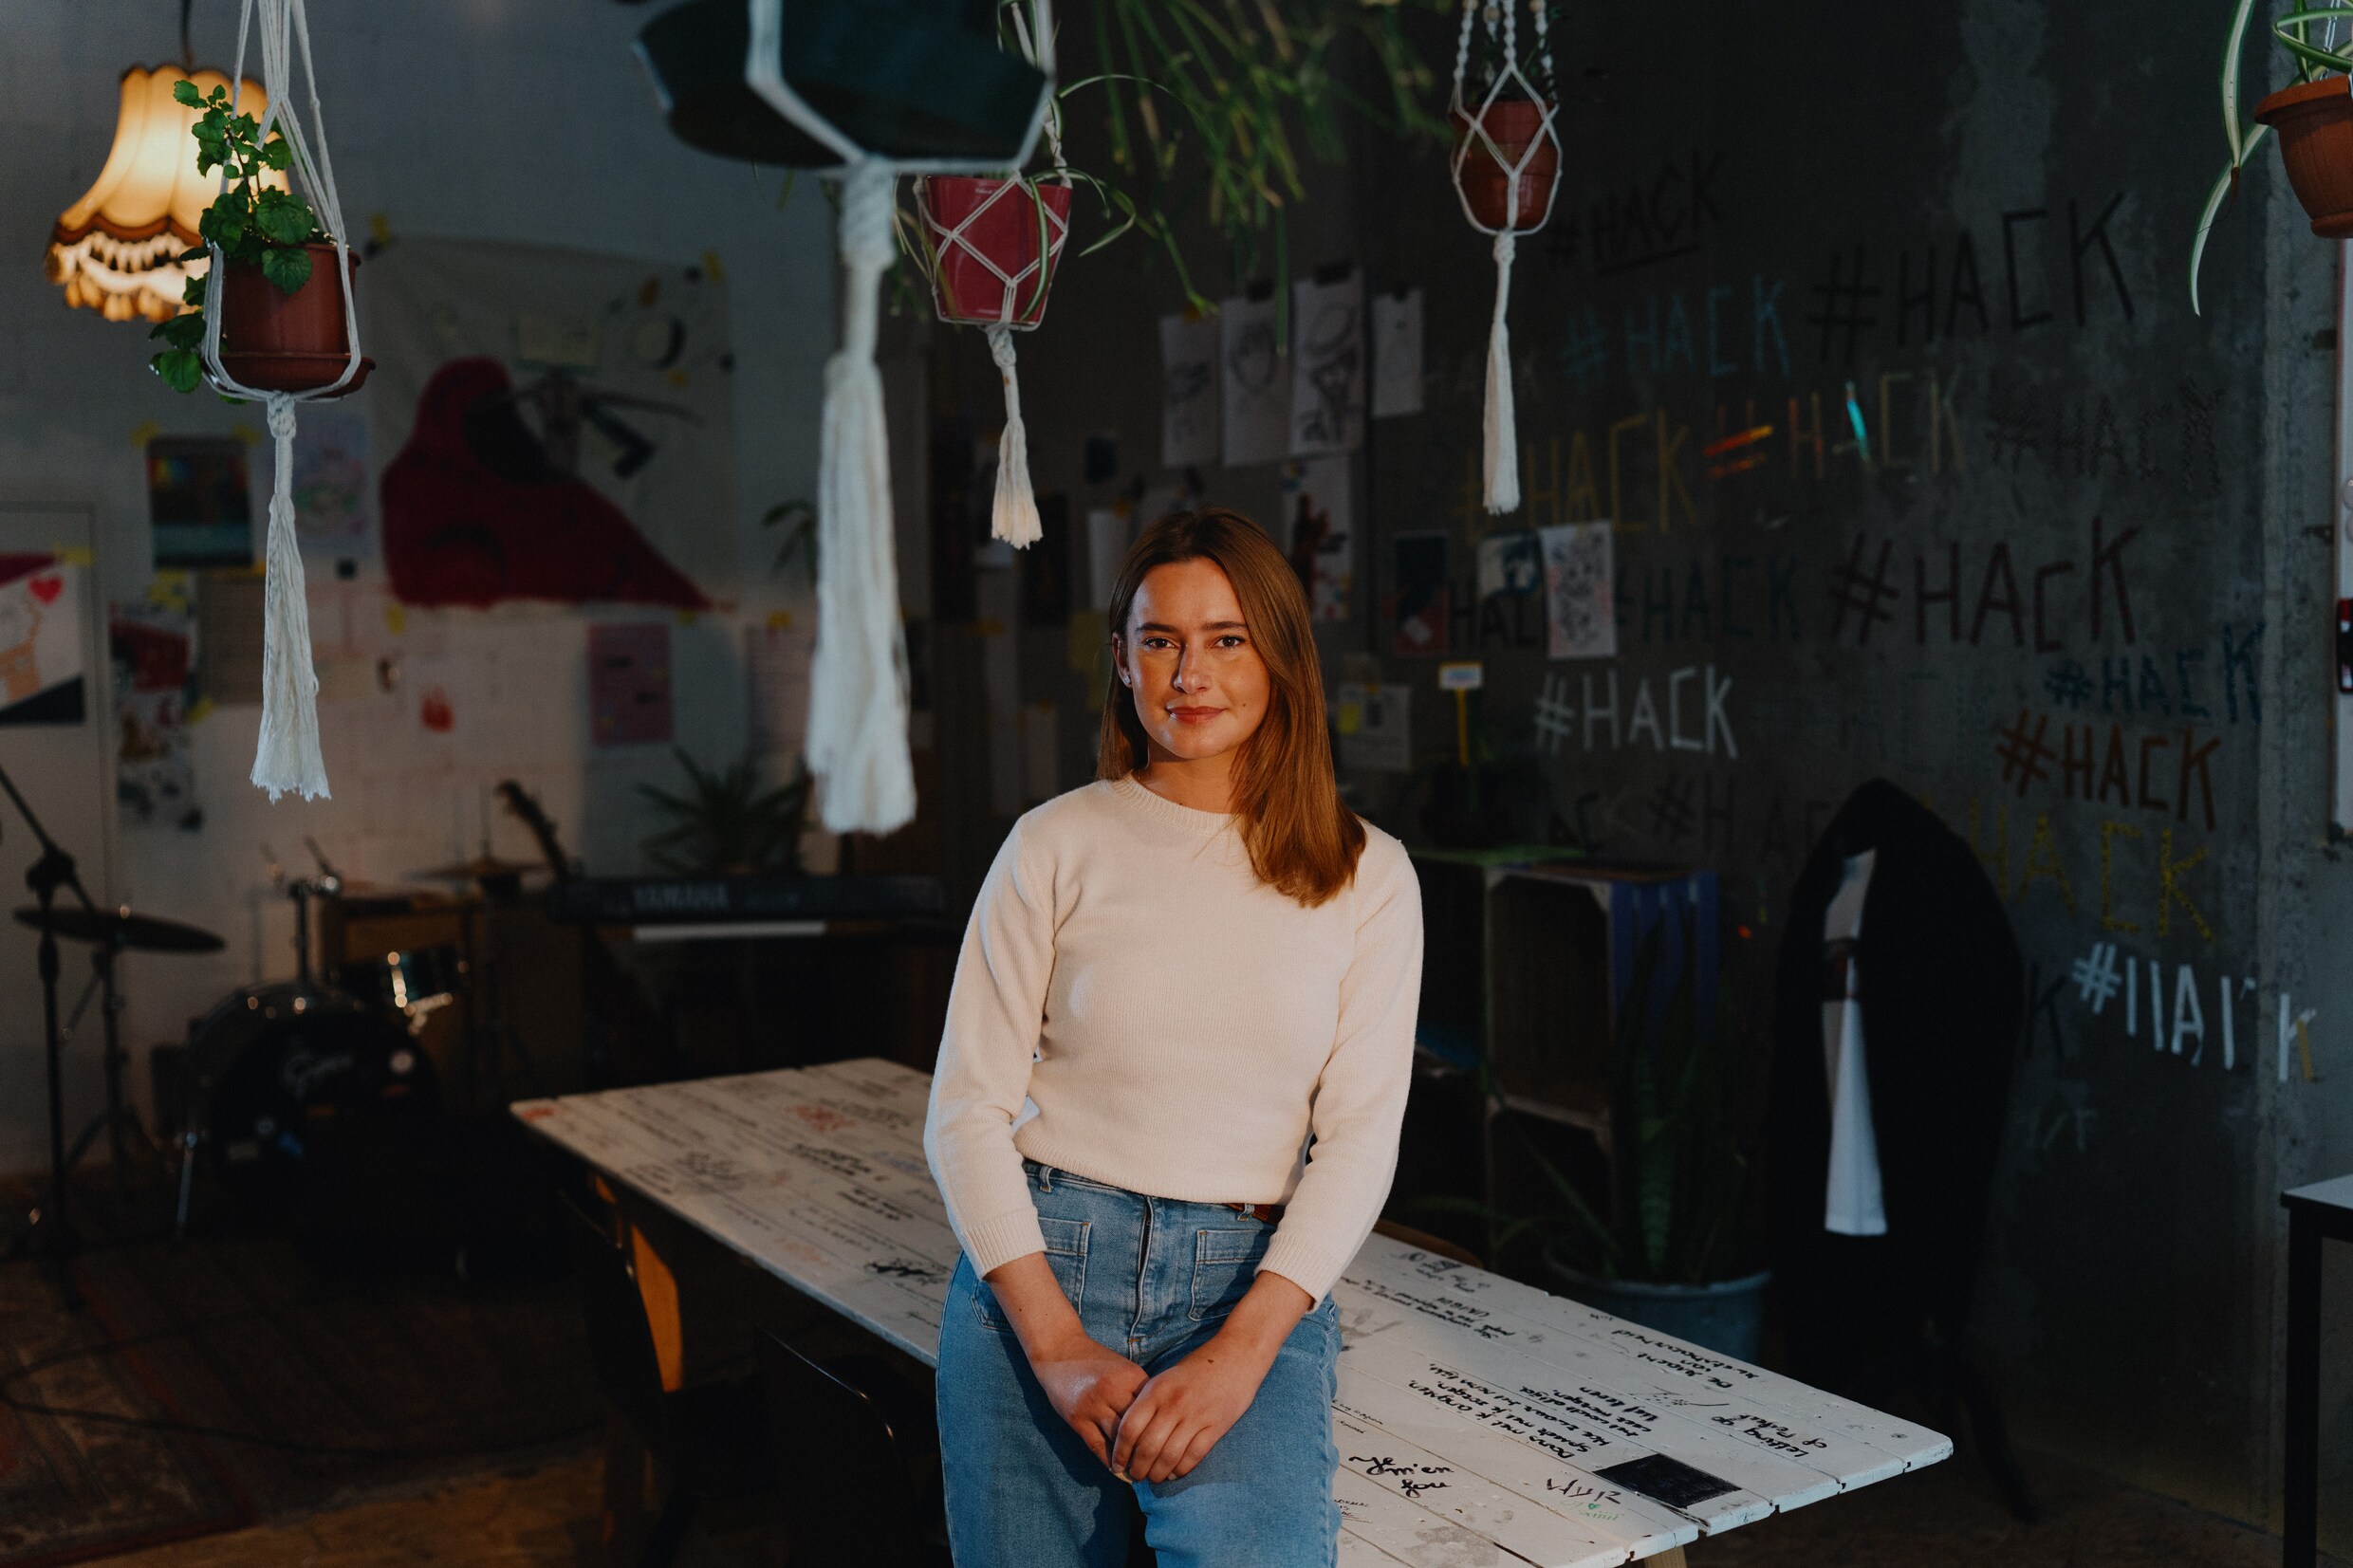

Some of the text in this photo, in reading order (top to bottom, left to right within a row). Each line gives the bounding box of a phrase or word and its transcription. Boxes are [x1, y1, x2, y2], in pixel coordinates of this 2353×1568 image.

[1558, 272, 1792, 392] #HACK
[1807, 192, 2135, 364] #HACK
[1829, 517, 2141, 653] #HACK
[1533, 663, 1739, 760] #HACK
[2043, 621, 2267, 725] #HACK
[1995, 709, 2222, 832] #HACK
